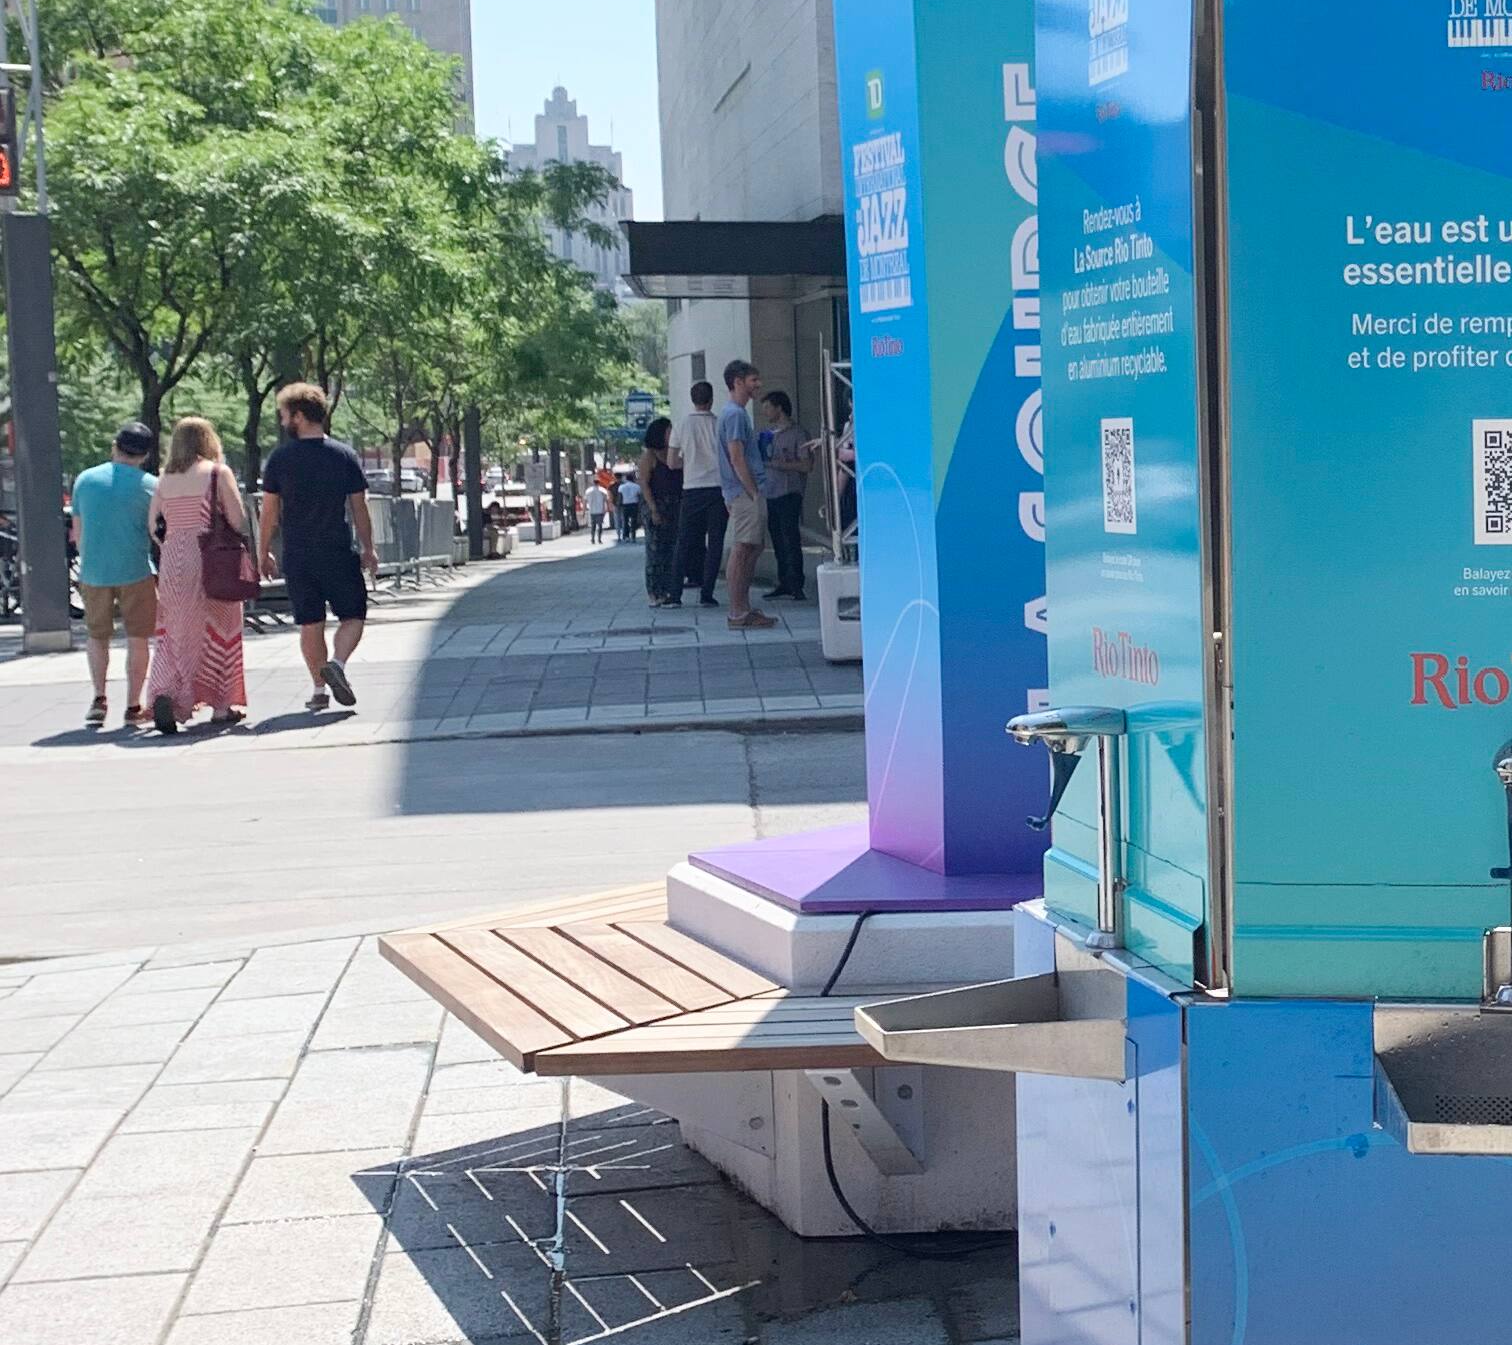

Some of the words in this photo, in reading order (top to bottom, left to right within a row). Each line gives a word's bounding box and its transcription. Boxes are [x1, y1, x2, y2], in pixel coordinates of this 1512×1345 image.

[857, 187, 909, 256] JAZZ
[1083, 202, 1134, 235] Rendez-vous
[1345, 215, 1432, 246] L'eau
[1441, 217, 1489, 244] est
[1074, 248, 1084, 274] La
[1086, 242, 1113, 269] Source
[1114, 238, 1128, 266] Rio
[1130, 233, 1153, 263] Tinto
[1343, 254, 1511, 287] essentielle
[1062, 291, 1080, 316] pour
[1081, 279, 1108, 308] obtenir
[1110, 277, 1130, 302] votre
[1132, 267, 1169, 300] bouteille
[1351, 312, 1418, 336] Merci
[1424, 312, 1453, 335] de
[1068, 361, 1077, 381] en
[1079, 351, 1120, 380] aluminium
[1347, 348, 1371, 369] et
[1376, 346, 1406, 369] de
[1412, 344, 1498, 373] profiter
[1463, 567, 1511, 582] Balayez
[1453, 586, 1469, 596] en
[1472, 585, 1508, 596] savoir
